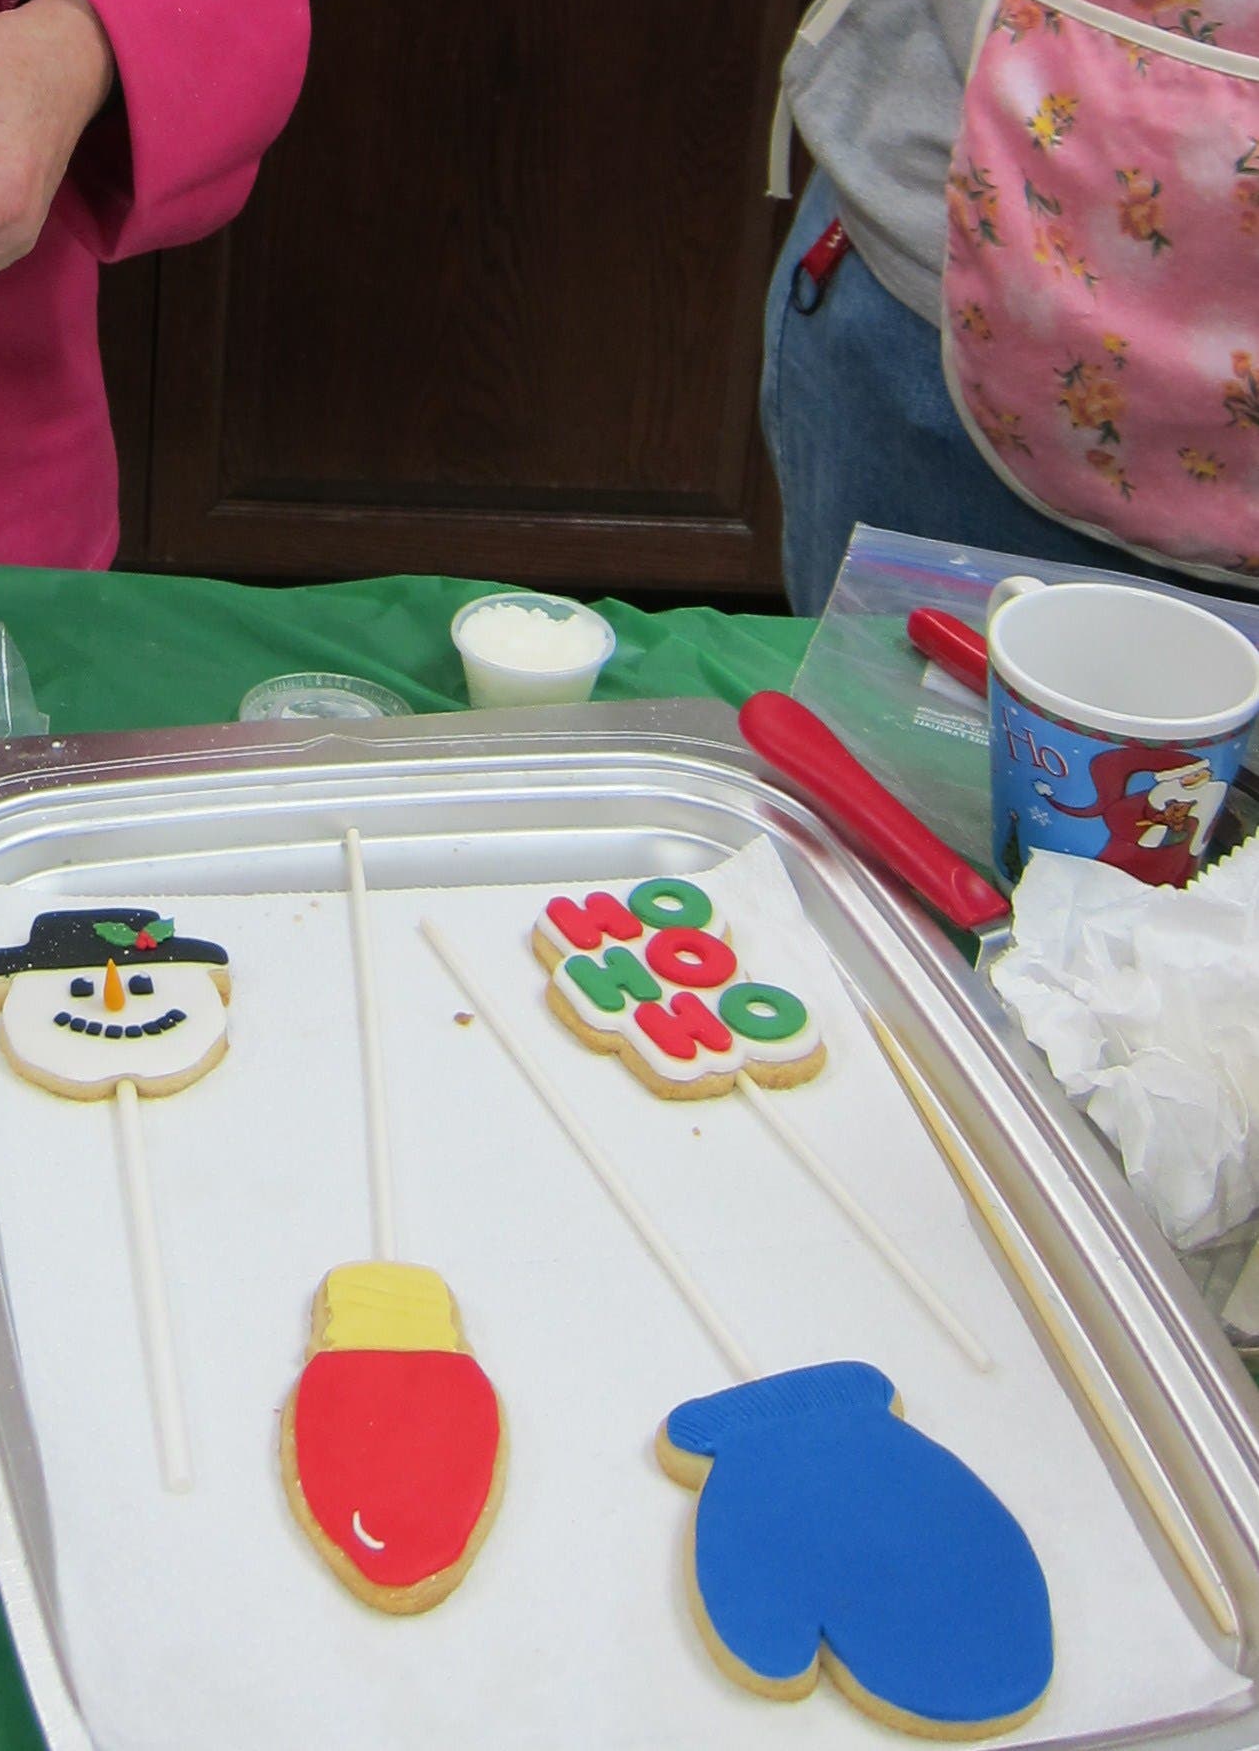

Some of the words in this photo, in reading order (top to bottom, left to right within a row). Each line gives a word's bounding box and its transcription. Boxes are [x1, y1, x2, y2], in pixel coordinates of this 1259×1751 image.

[1002, 705, 1069, 778] Ho
[546, 878, 713, 951] HO
[565, 926, 737, 1012] HO
[634, 982, 807, 1060] HO
